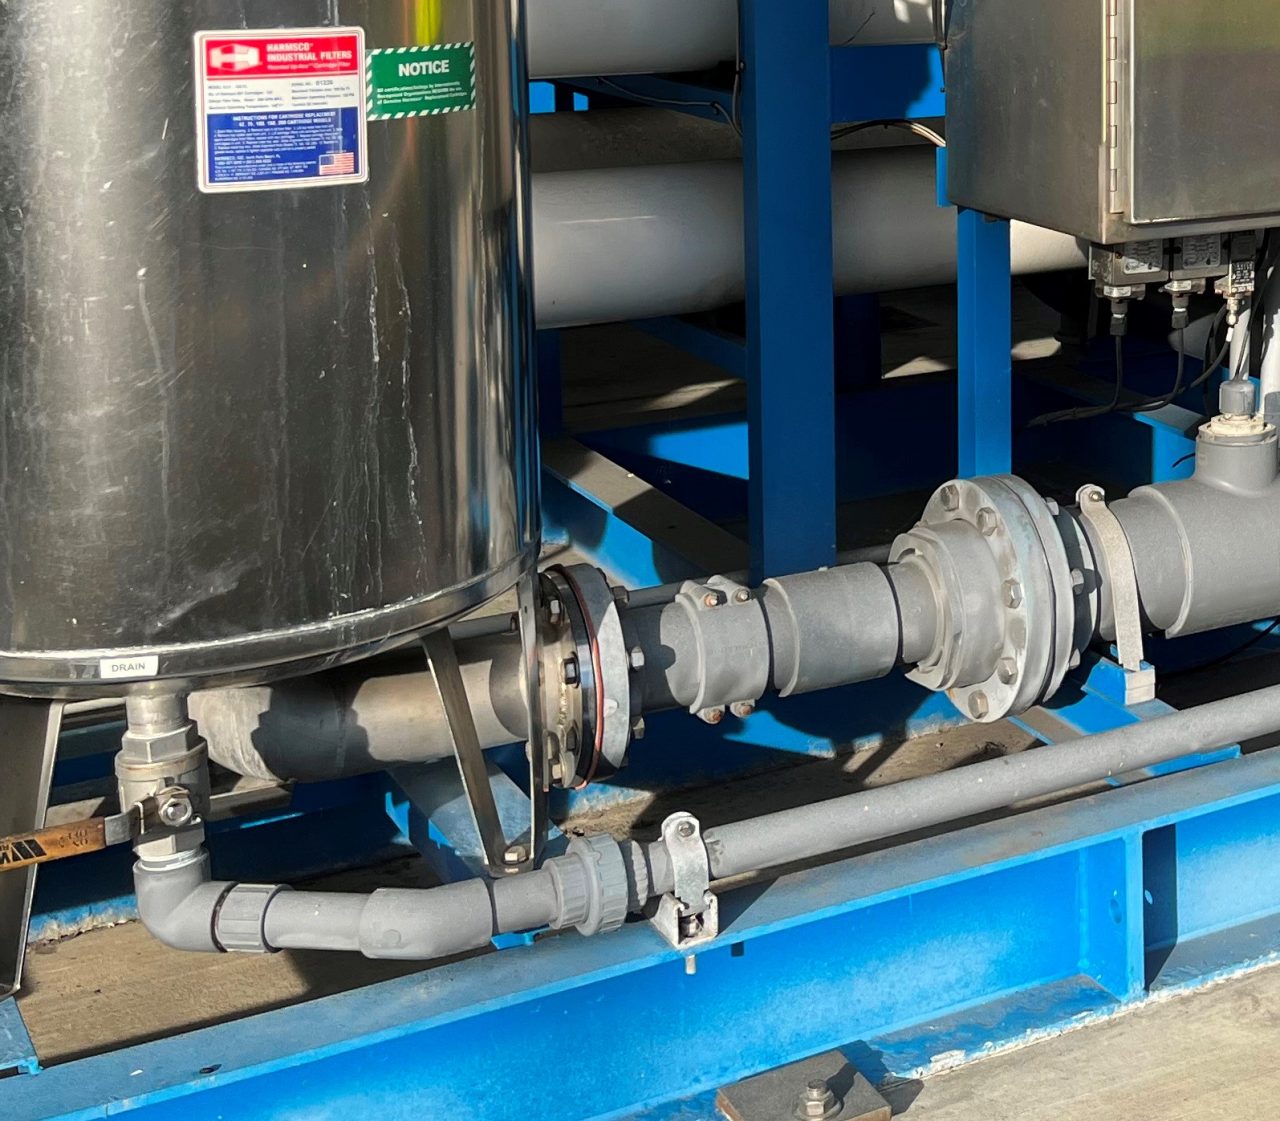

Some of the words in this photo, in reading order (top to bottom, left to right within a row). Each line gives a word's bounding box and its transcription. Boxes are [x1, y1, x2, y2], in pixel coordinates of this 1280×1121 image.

[266, 51, 318, 62] INDUSTRIAL
[320, 50, 353, 61] FILTERS
[398, 59, 450, 77] NOTICE
[111, 662, 146, 672] DRAIN
